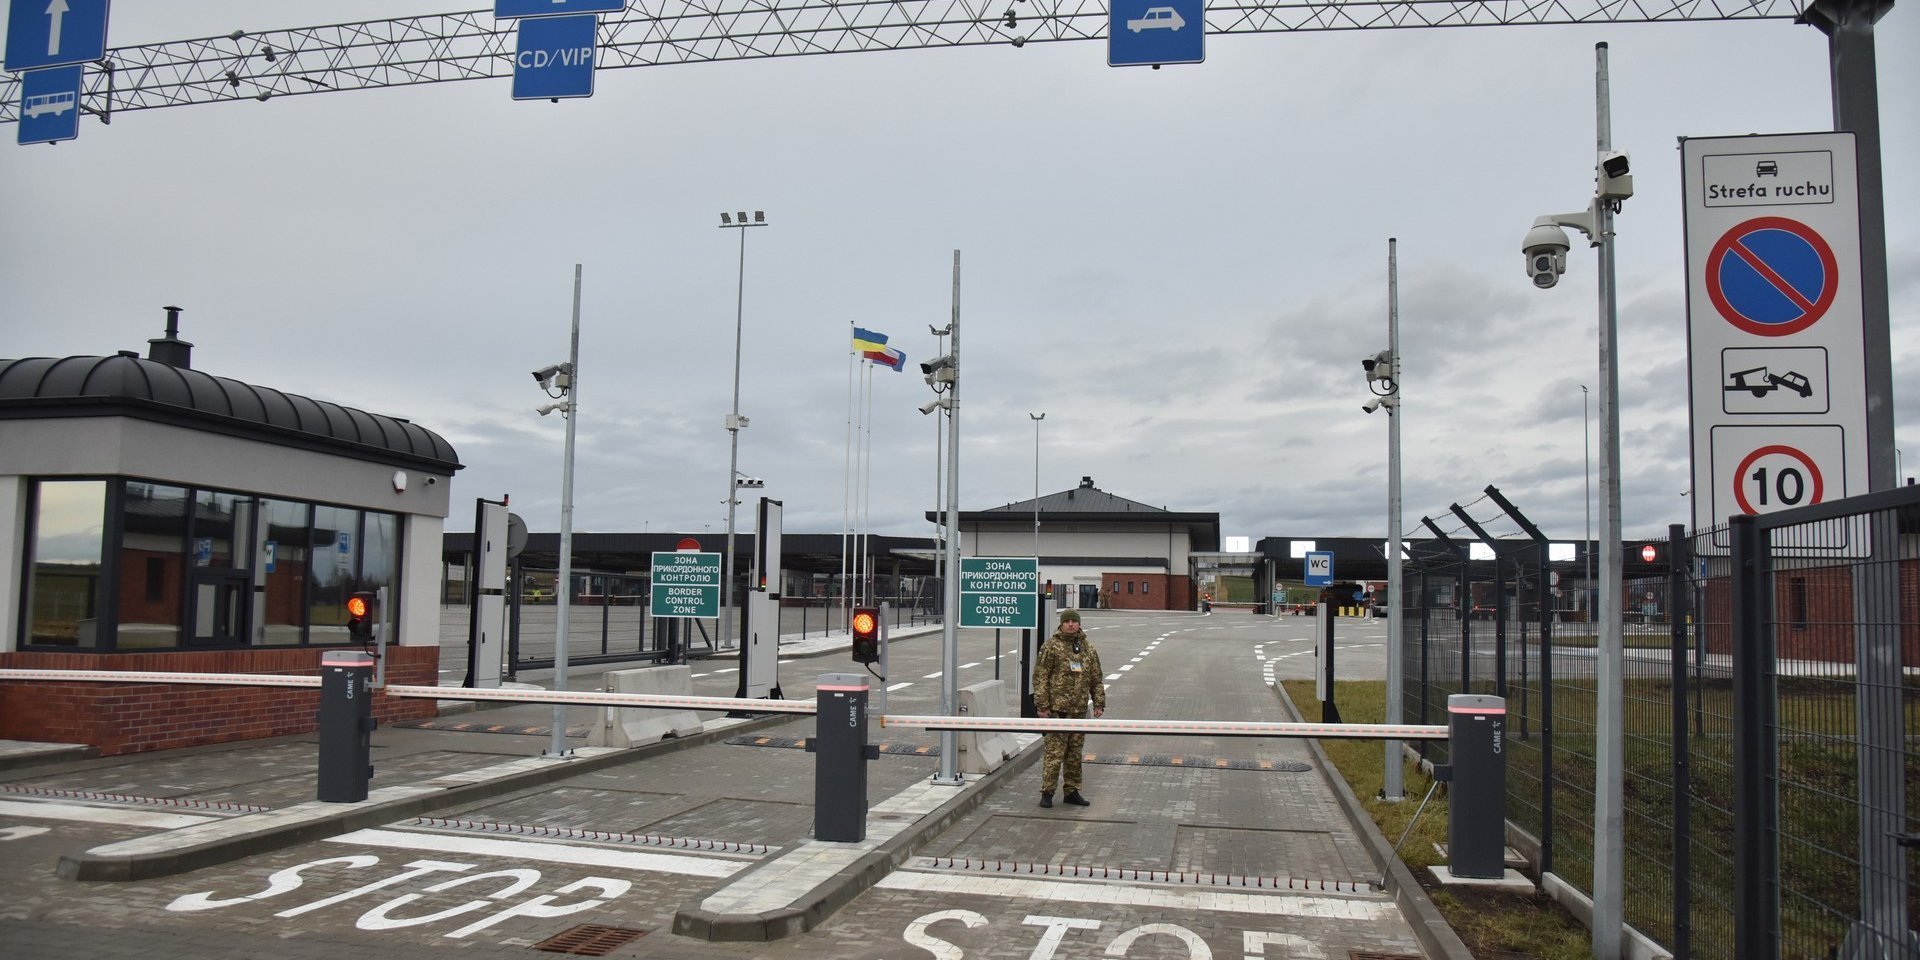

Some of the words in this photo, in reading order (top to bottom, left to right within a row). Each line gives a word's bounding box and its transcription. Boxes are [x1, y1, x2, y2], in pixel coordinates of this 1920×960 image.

[517, 47, 592, 69] CD/VIP
[1709, 183, 1767, 199] Strefa
[1775, 181, 1829, 197] ruchu
[1752, 467, 1804, 506] 10
[674, 556, 698, 564] ЗОНА
[1310, 559, 1328, 568] WC
[653, 565, 719, 574] ПРИКОРДОННОГО
[985, 562, 1012, 570] ЗОНА
[660, 574, 711, 582] КОНТРОЛЮ
[961, 571, 1036, 581] ПРИКОРДОННОГО
[970, 581, 1027, 590] КОНТРОЛЮ
[668, 588, 702, 596] BORDER
[665, 597, 705, 605] CONTROL
[979, 596, 1018, 605] BORDER
[672, 606, 697, 614] ZONE
[975, 605, 1021, 615] CONTROL
[984, 616, 1011, 624] ZONE
[346, 679, 354, 699] CAME
[849, 706, 857, 728] CAME
[1493, 730, 1501, 754] CAME
[165, 855, 632, 938] STOP
